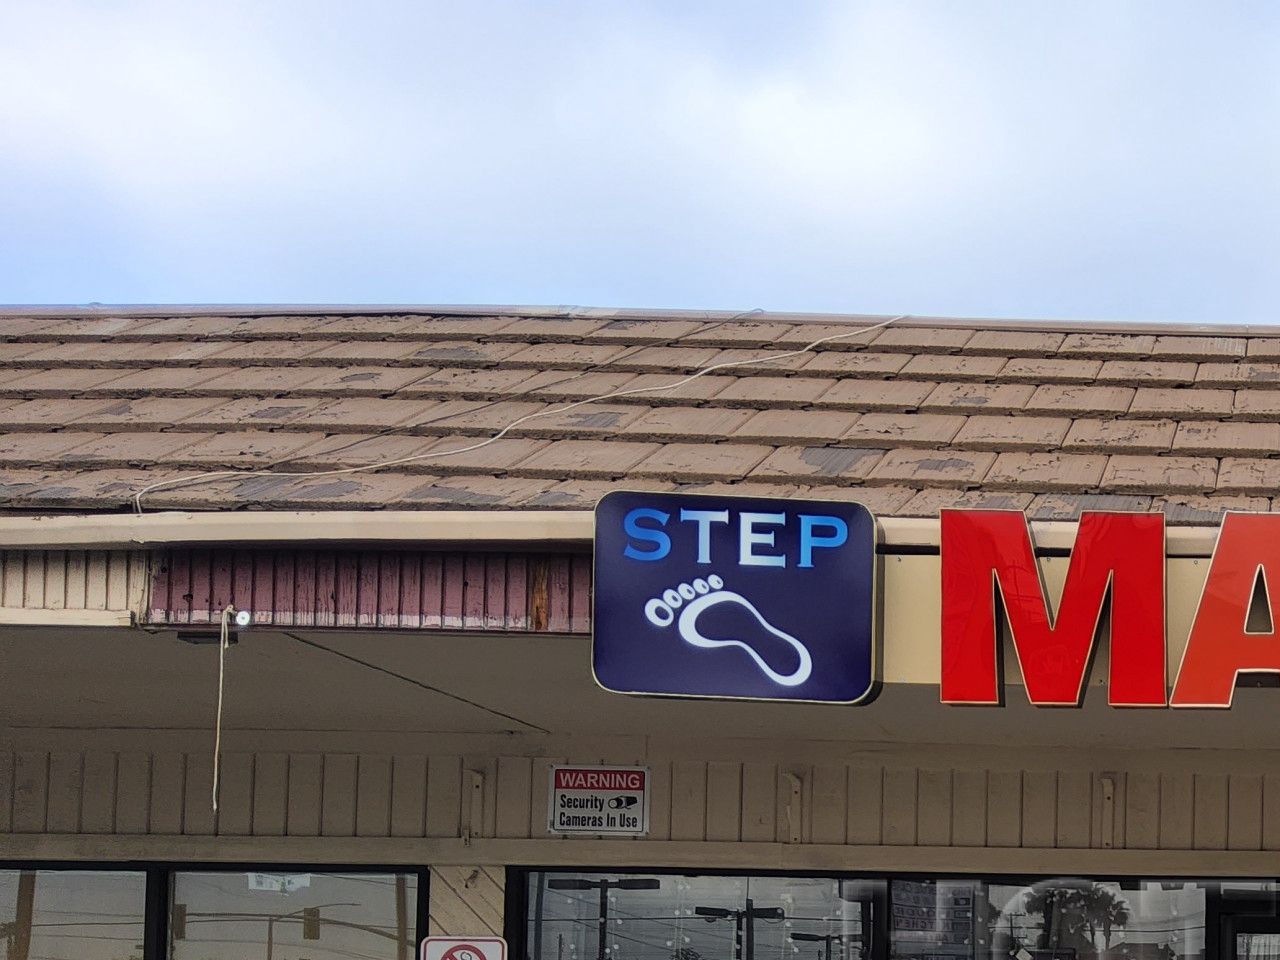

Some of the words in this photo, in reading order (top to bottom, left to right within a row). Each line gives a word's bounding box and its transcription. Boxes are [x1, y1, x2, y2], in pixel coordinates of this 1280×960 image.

[623, 508, 848, 568] STEP
[560, 772, 640, 788] WARNING
[560, 794, 604, 812] Security
[560, 812, 603, 827] Cameras
[607, 813, 616, 827] In
[620, 813, 637, 828] Use
